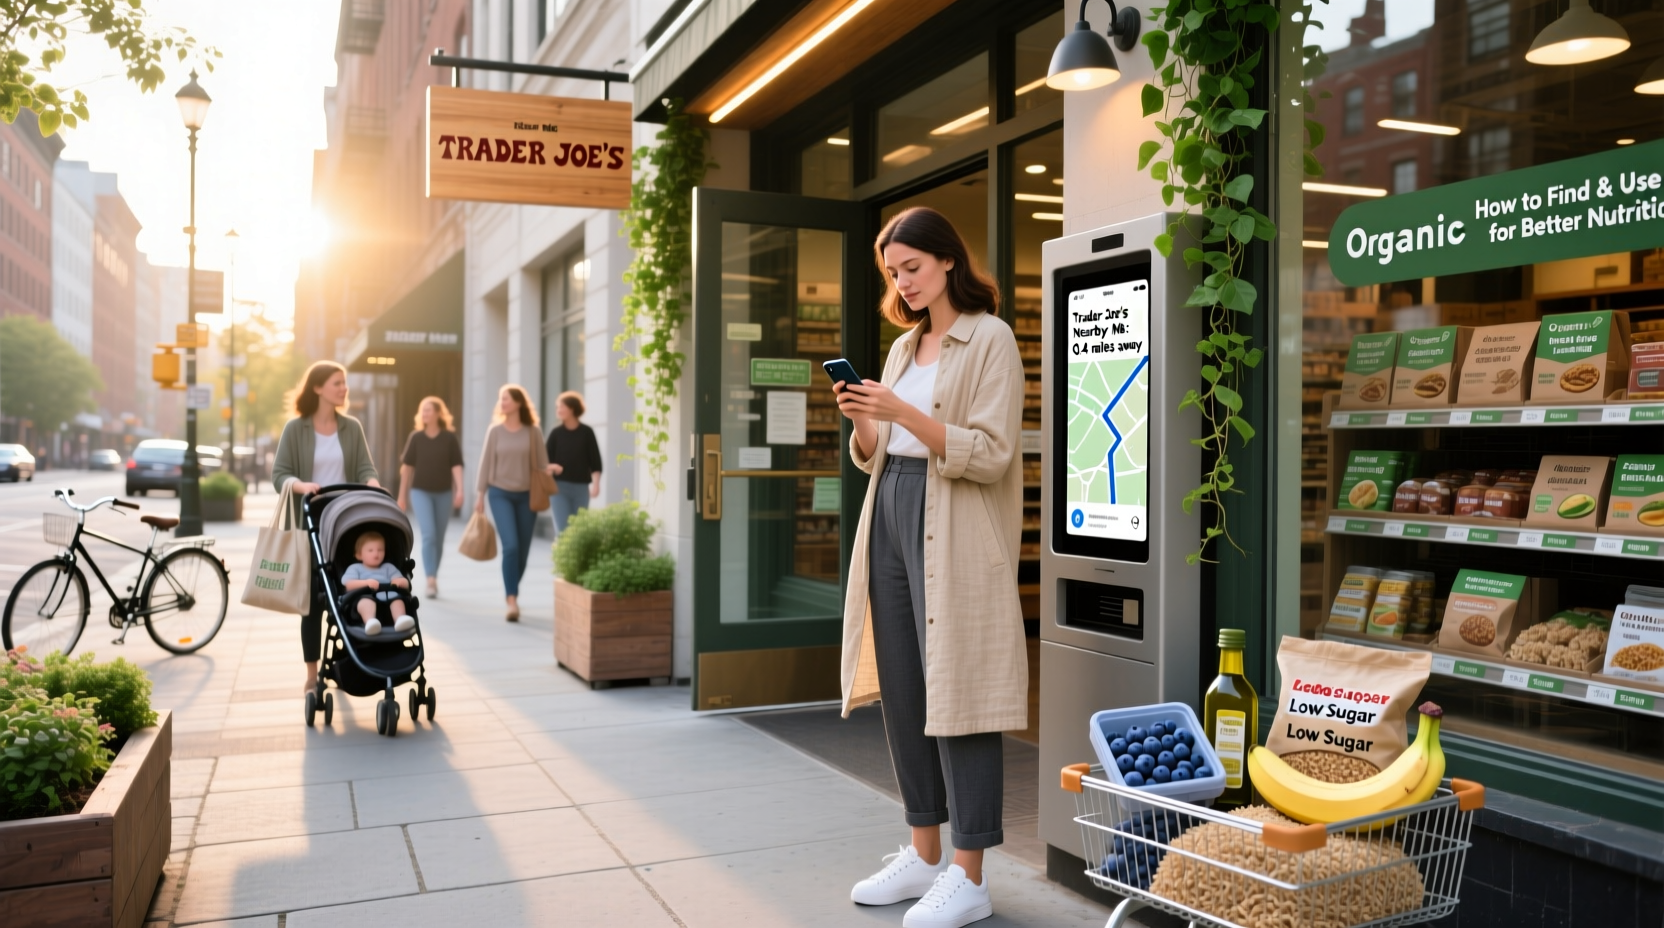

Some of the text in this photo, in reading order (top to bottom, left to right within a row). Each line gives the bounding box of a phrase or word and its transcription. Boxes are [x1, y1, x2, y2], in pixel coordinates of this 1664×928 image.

[438, 134, 624, 170] TRADER JOE'S
[1475, 171, 1662, 220] How to Find & Use
[1346, 213, 1466, 265] Organic
[1489, 222, 1517, 243] for
[1521, 214, 1583, 238] Better
[1289, 698, 1377, 725] Low Sugar
[1286, 723, 1374, 753] Low Sugar
